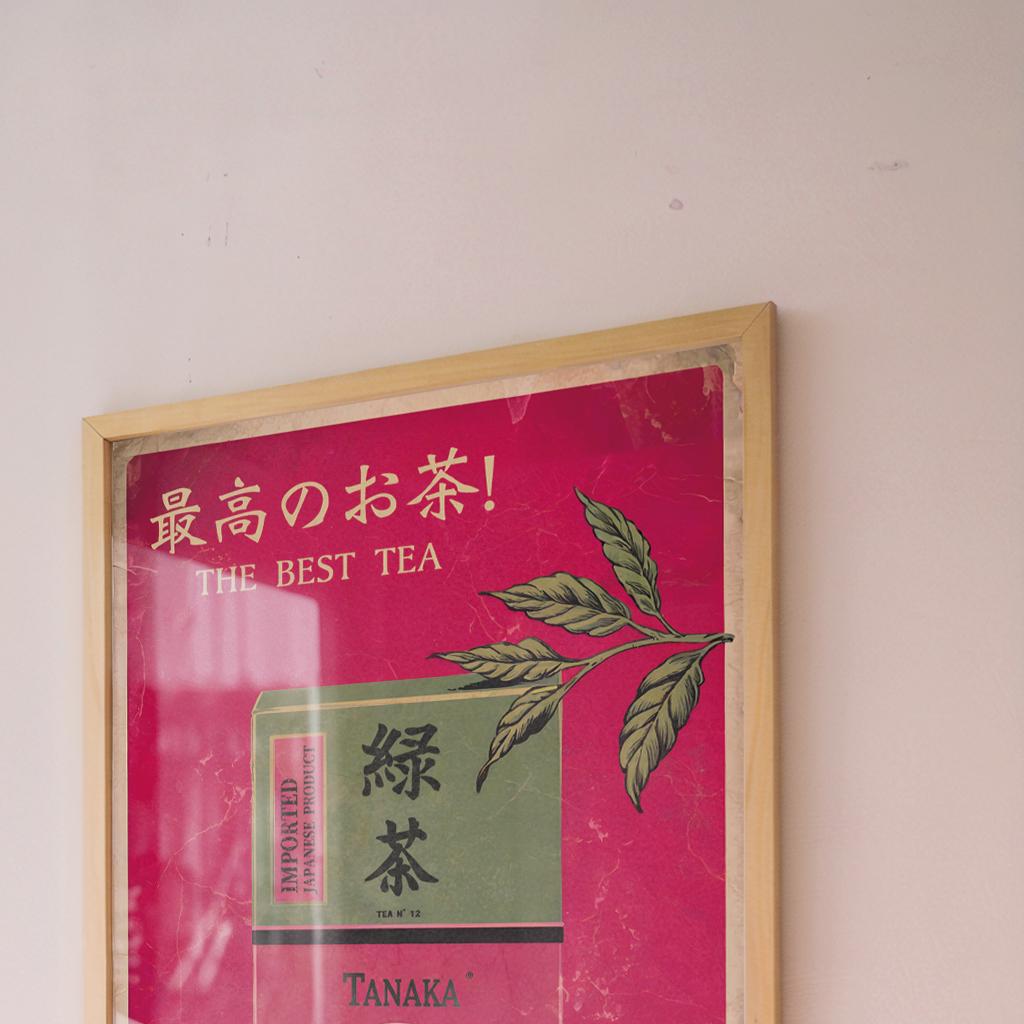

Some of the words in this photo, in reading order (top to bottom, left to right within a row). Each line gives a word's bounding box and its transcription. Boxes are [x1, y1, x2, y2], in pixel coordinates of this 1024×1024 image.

[195, 564, 257, 597] THE
[276, 552, 356, 588] BEST
[374, 542, 442, 577] TEA
[303, 745, 316, 815] PRODUCT
[280, 777, 299, 894] IMPORTED
[303, 822, 317, 895] JAPANESE
[376, 910, 394, 919] TEA
[410, 909, 421, 918] 12
[342, 972, 461, 1008] TANAKA
